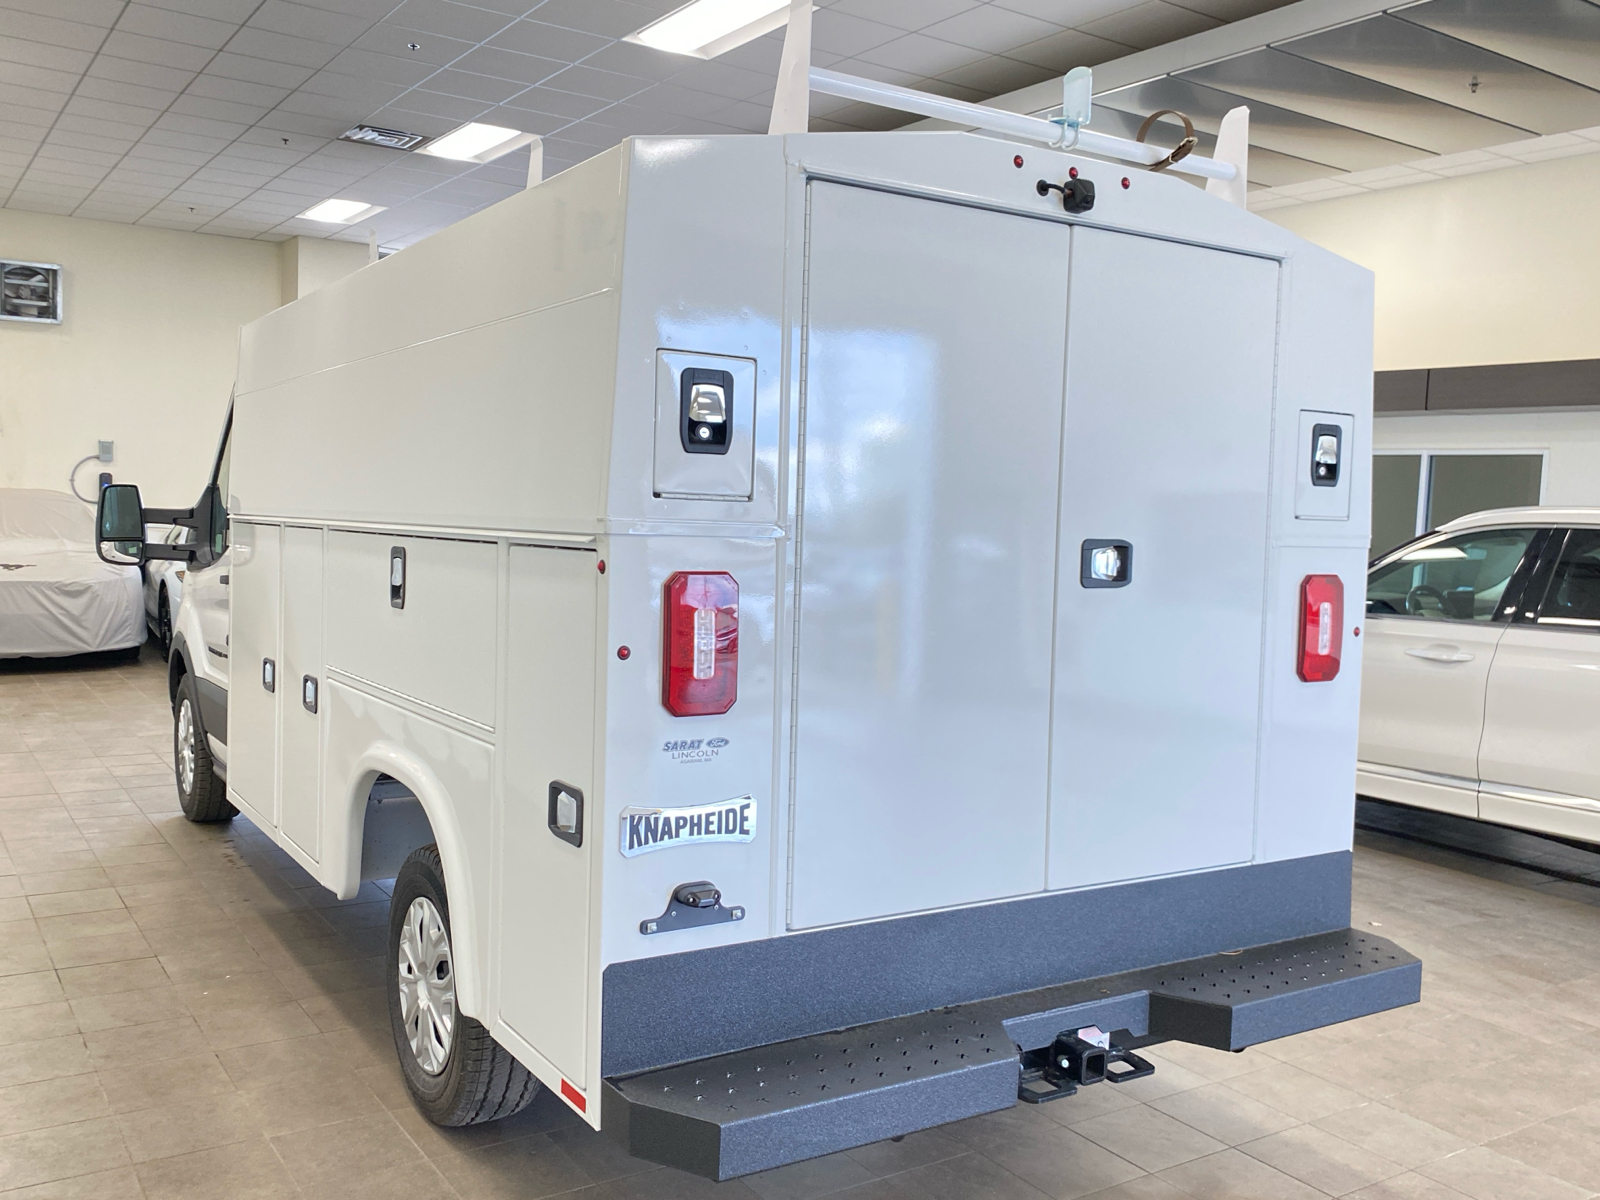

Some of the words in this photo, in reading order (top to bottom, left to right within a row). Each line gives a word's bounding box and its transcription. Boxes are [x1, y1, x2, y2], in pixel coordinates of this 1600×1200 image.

[662, 739, 704, 752] SARAT
[707, 737, 729, 748] Ford
[672, 749, 719, 759] LINCOLN
[628, 802, 750, 850] KNAPHEIDE
